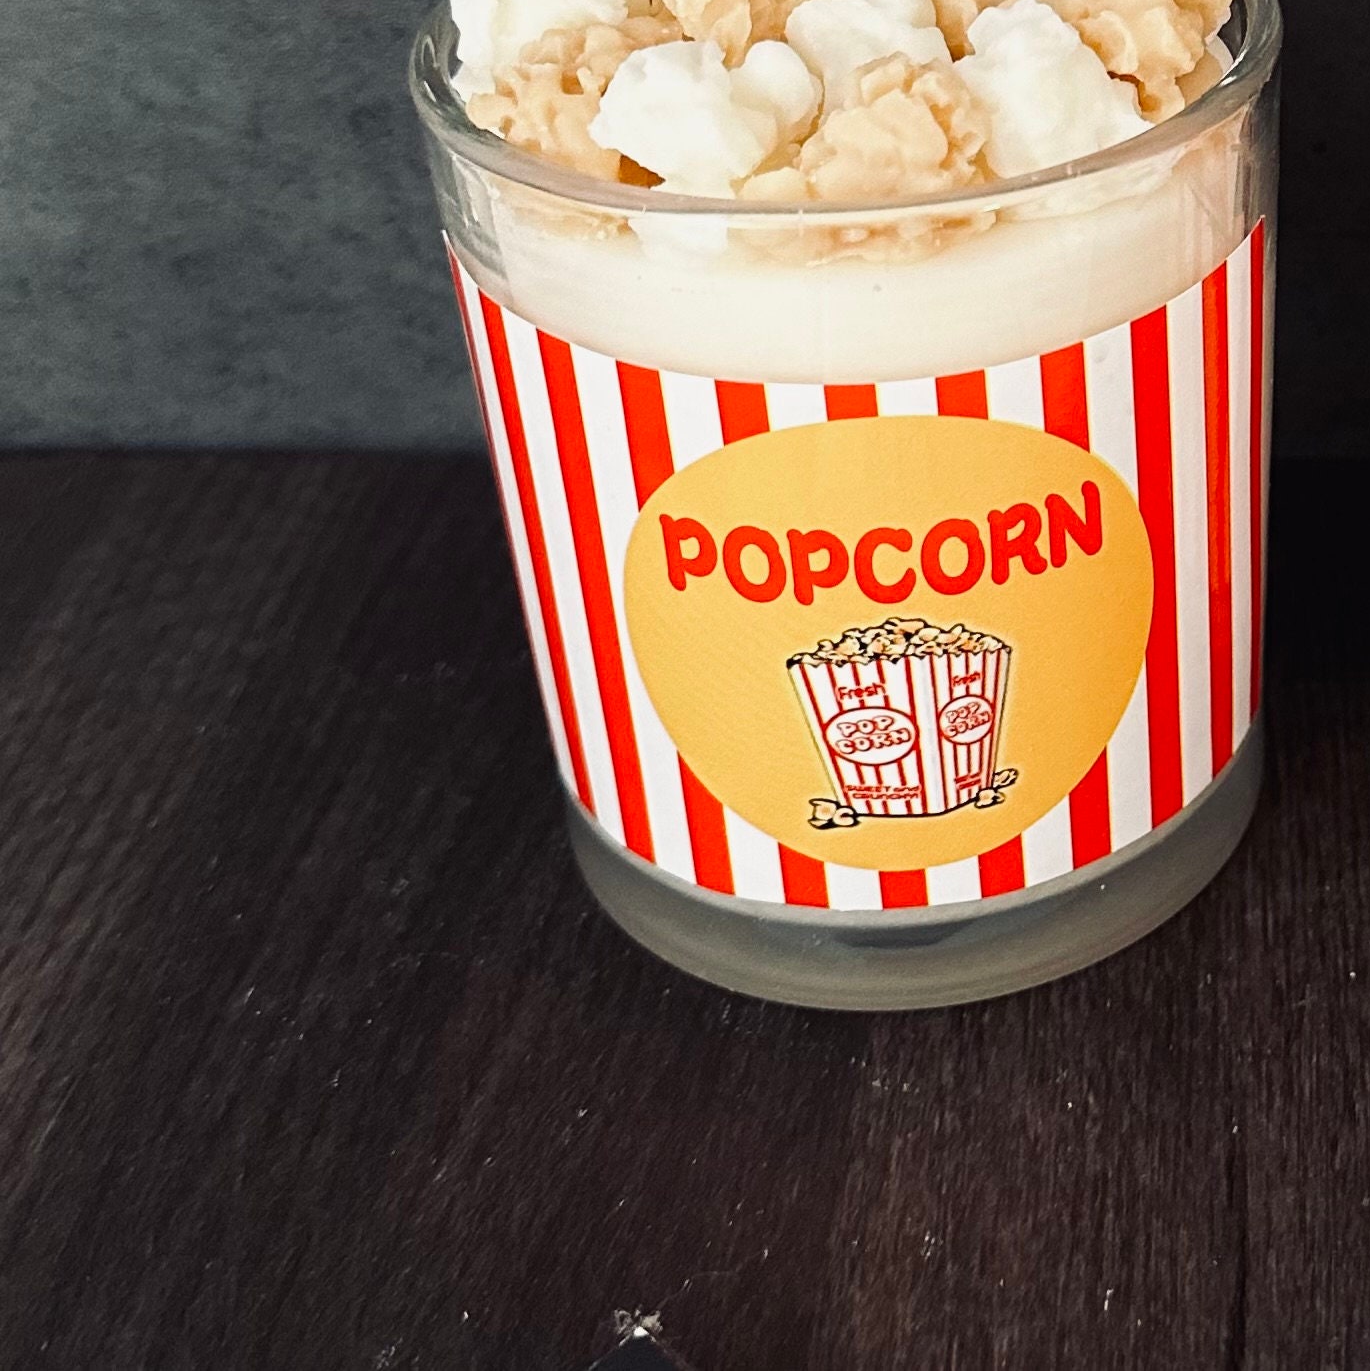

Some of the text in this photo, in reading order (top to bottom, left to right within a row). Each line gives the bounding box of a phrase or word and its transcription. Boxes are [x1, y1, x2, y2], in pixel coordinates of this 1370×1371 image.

[659, 480, 1102, 606] POPCORN
[951, 671, 981, 686] Fresh
[838, 682, 886, 700] Fresh
[944, 711, 991, 737] CORN
[945, 702, 981, 723] POP
[836, 715, 895, 738] POP
[835, 728, 912, 754] CORN
